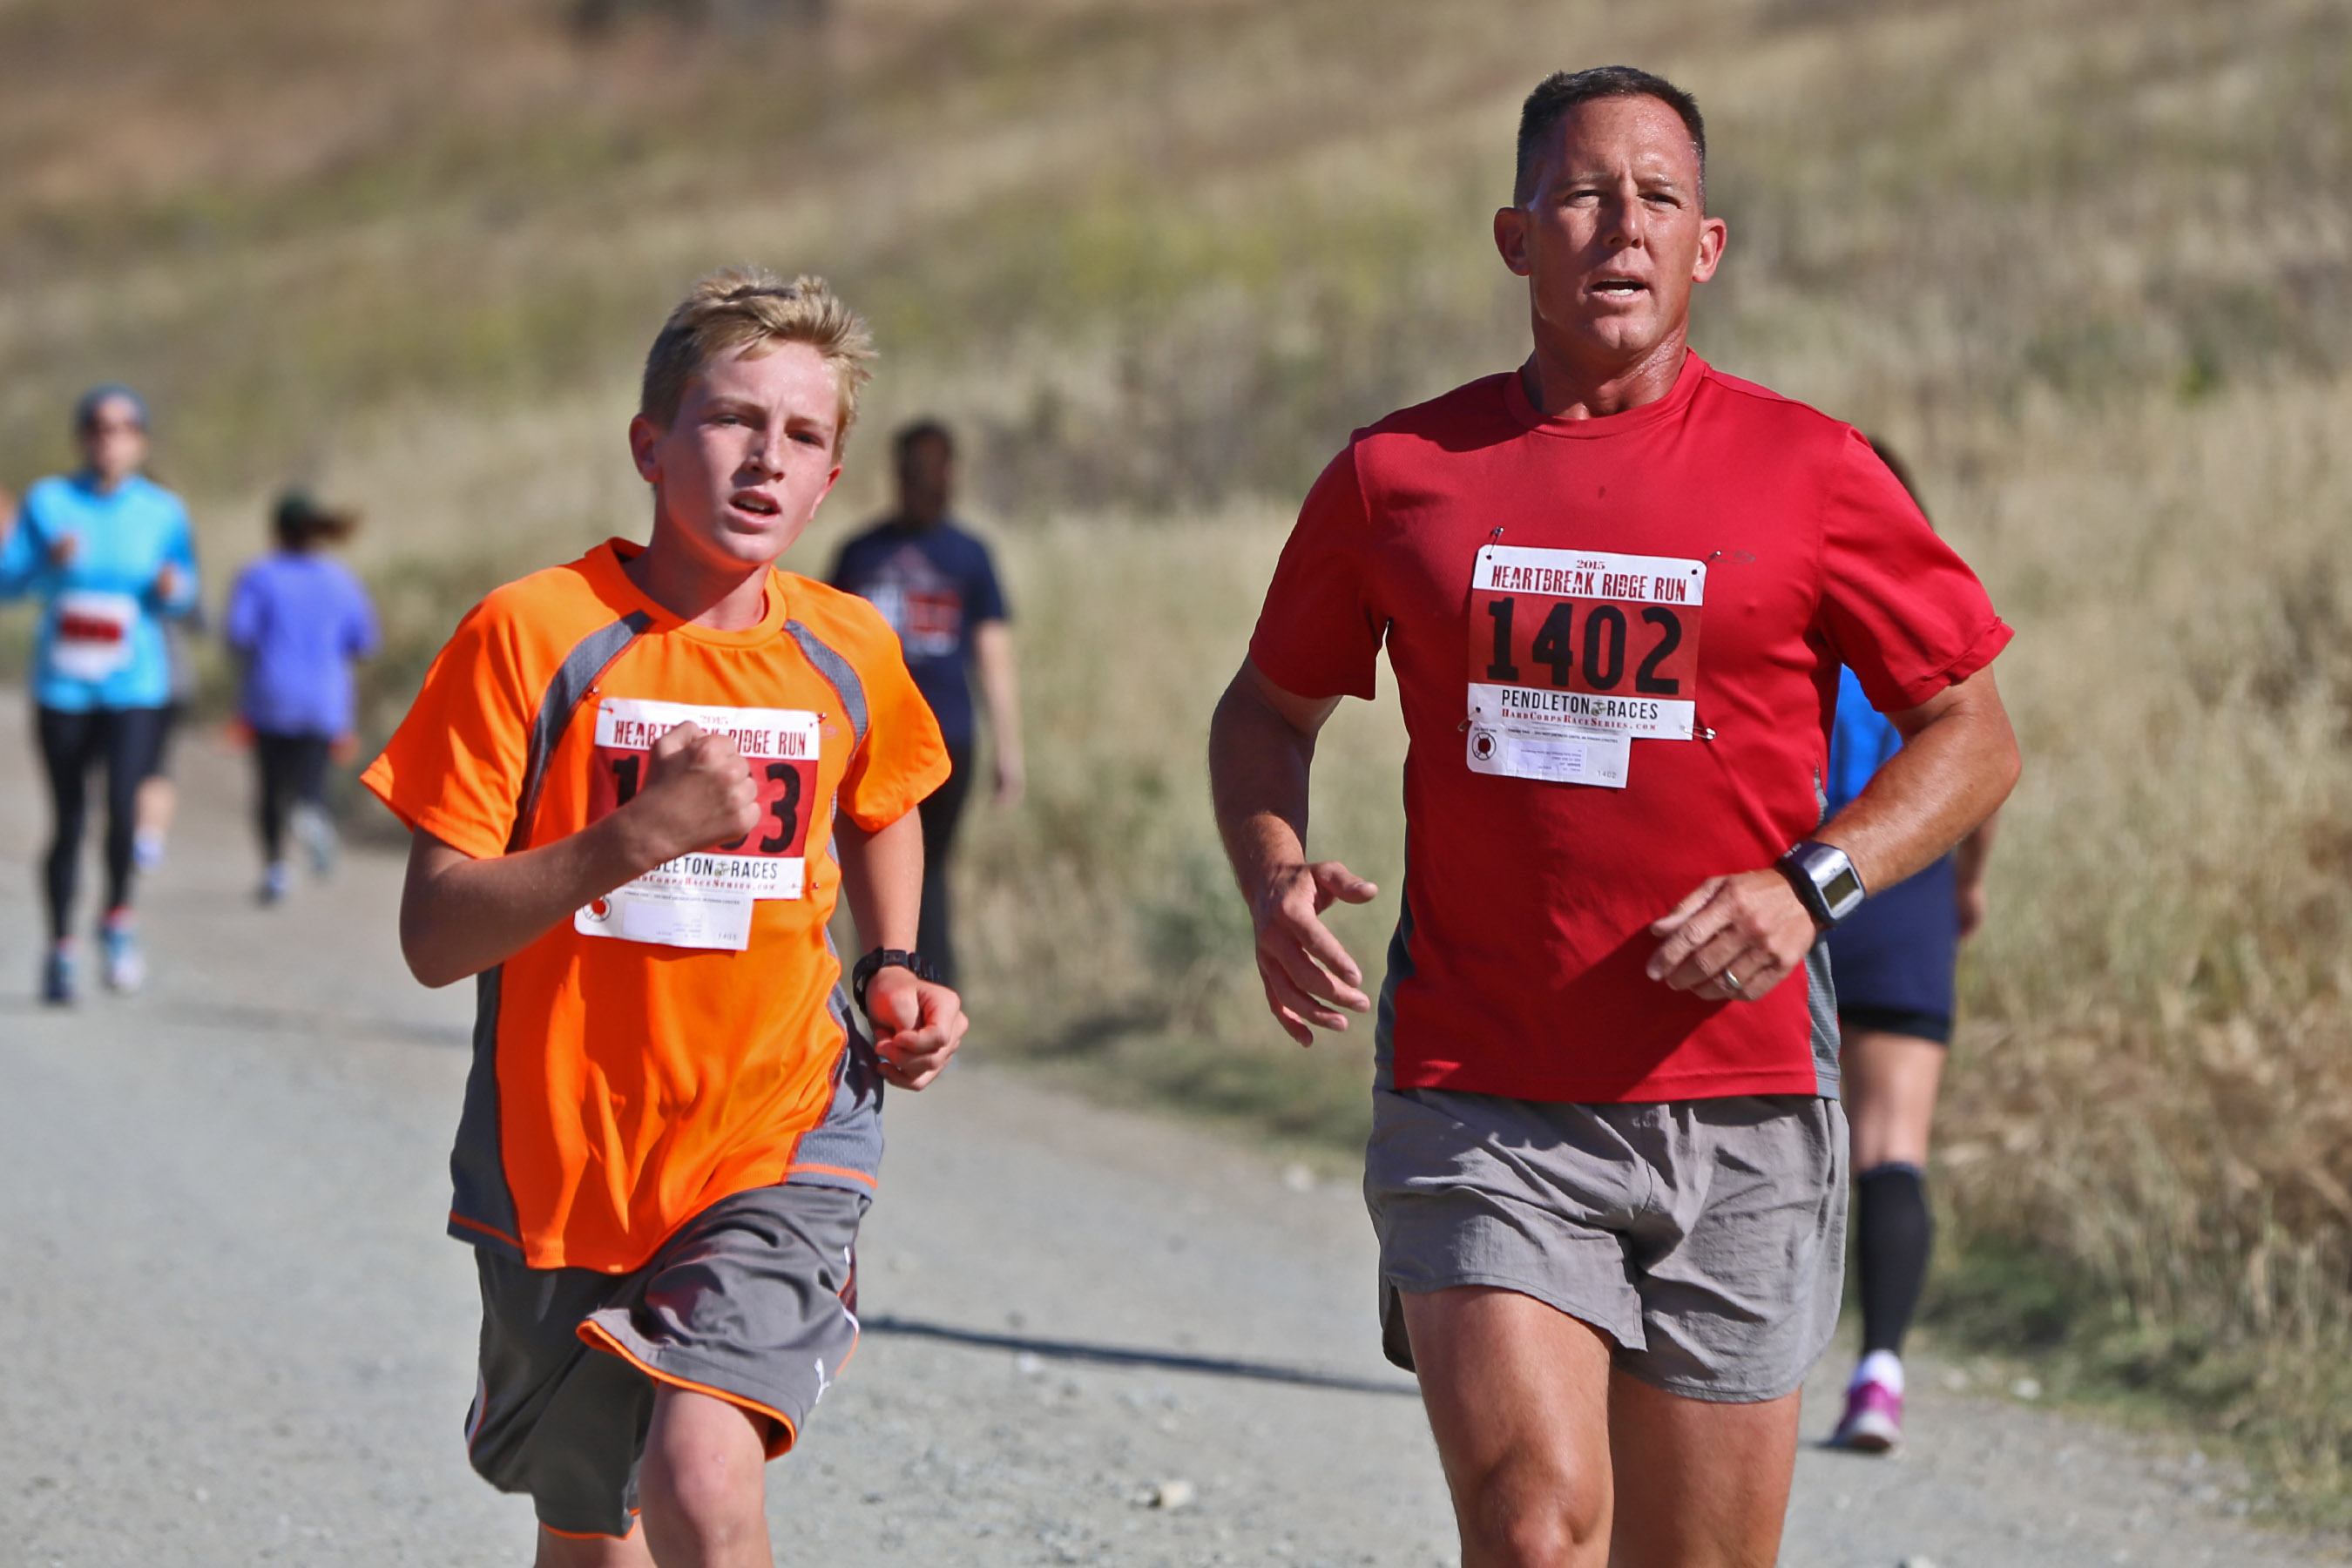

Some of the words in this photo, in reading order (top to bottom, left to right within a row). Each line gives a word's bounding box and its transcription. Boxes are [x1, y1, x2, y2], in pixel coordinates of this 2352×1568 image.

[1576, 559, 1605, 571] 2015
[1491, 565, 1594, 596] HEARTBREAK
[1602, 573, 1648, 599] RIDGE
[1655, 578, 1686, 602] RUN
[1486, 597, 1682, 695] 1402
[1502, 690, 1590, 714] PENDLETON
[1607, 700, 1659, 720] RACES
[613, 720, 720, 745] HEART
[778, 730, 807, 756] RUN
[1598, 769, 1617, 779] 1402
[612, 754, 801, 854] 13
[731, 861, 778, 880] RACES
